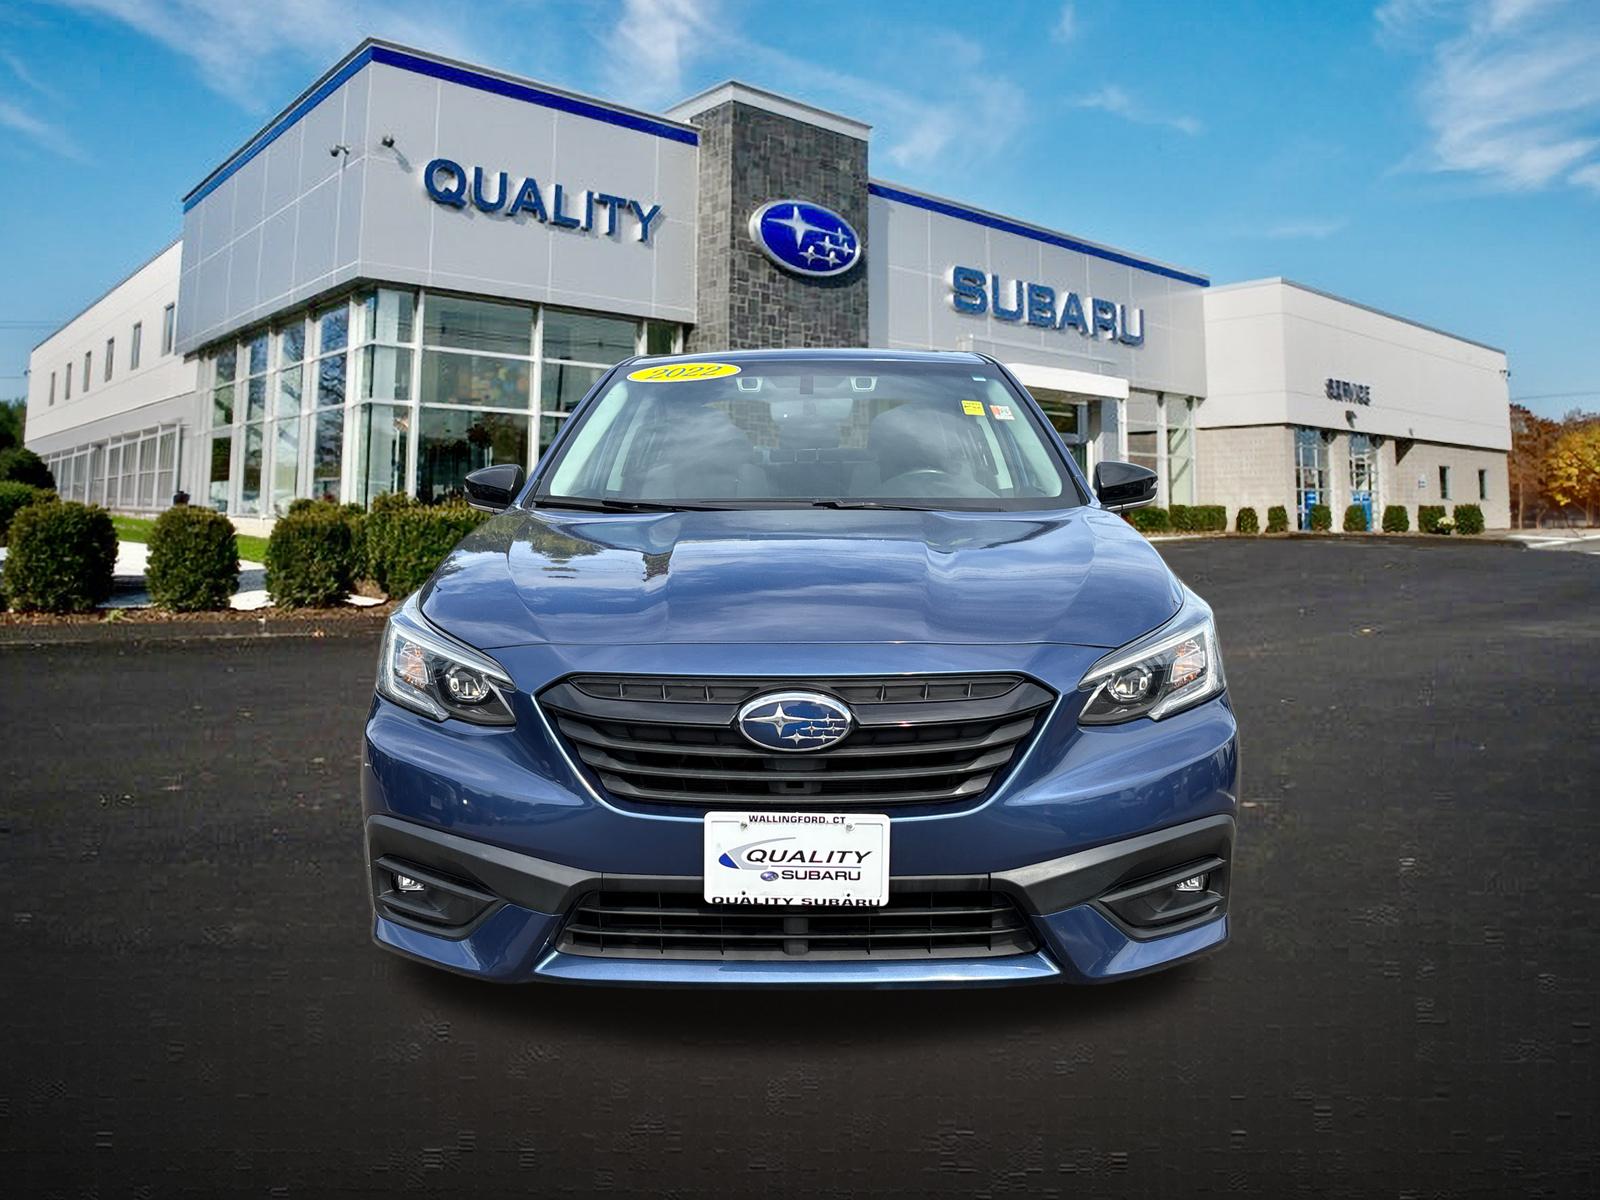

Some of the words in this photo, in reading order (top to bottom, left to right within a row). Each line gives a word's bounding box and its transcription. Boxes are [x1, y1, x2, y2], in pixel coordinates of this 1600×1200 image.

[423, 158, 662, 243] QUALITY
[950, 265, 1145, 347] SUBARU
[646, 365, 723, 380] 2022
[1325, 378, 1371, 406] SERVICE
[833, 816, 846, 824] CT
[746, 849, 872, 864] QUALITY
[781, 870, 861, 881] SUBARU
[711, 896, 794, 905] QUALITY
[801, 897, 881, 906] SUBARU
